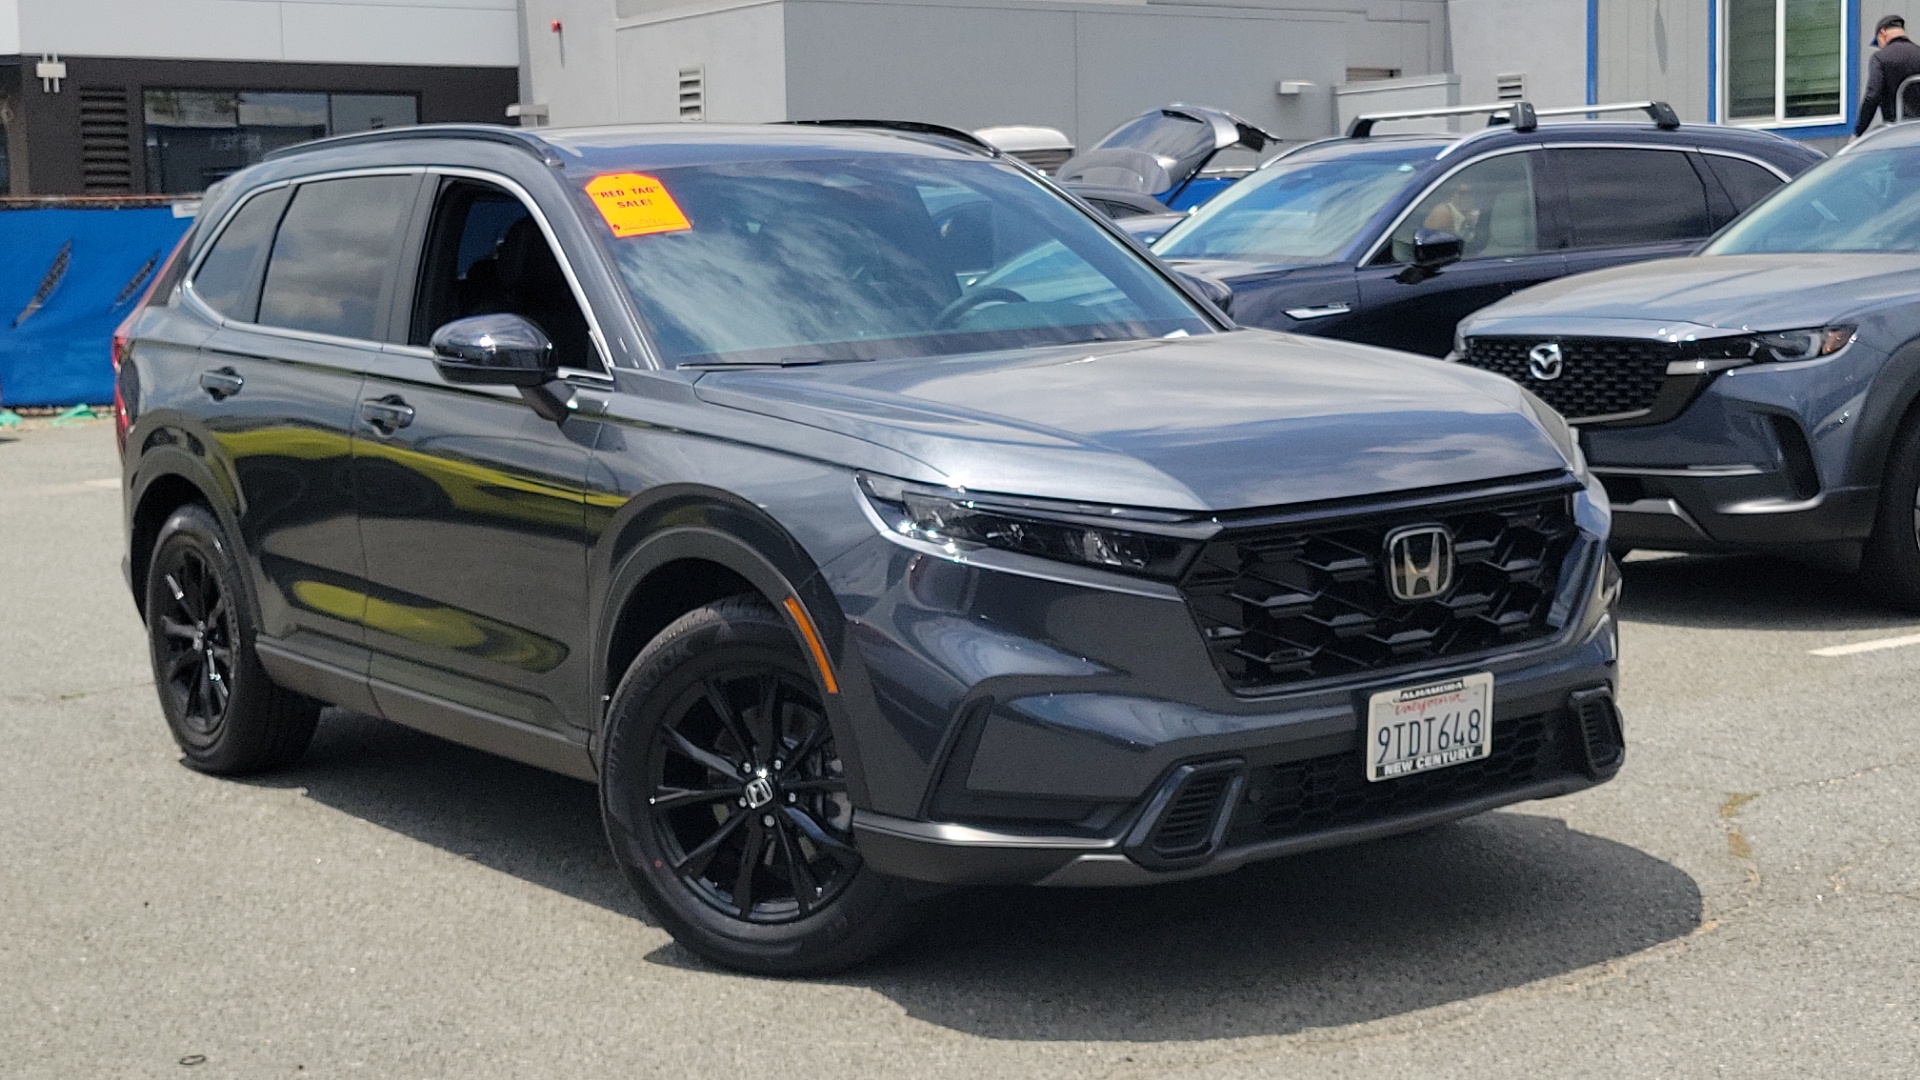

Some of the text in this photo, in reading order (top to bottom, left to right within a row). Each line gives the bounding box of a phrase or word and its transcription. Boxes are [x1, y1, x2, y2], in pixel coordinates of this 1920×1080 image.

[1377, 709, 1481, 764] 9TDT648
[1384, 746, 1475, 776] NEW CENTURY
